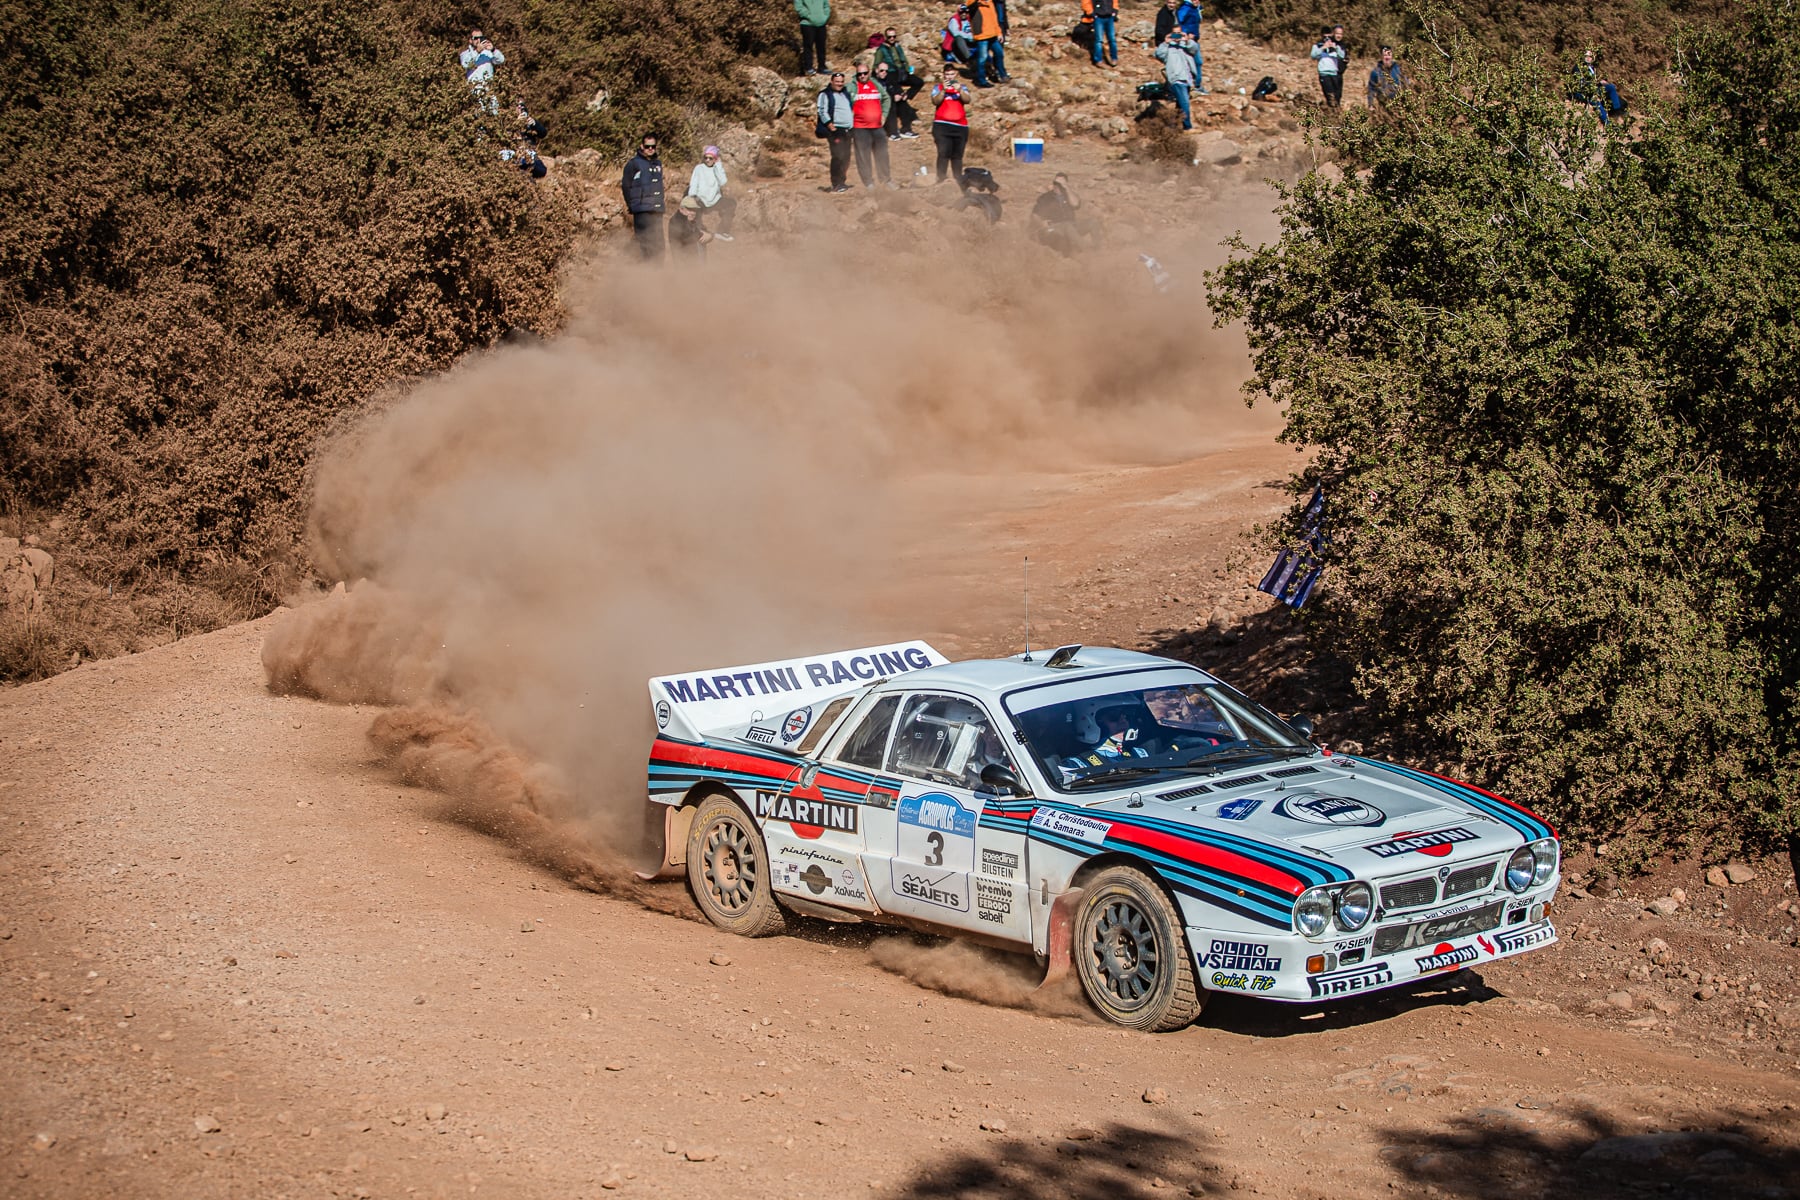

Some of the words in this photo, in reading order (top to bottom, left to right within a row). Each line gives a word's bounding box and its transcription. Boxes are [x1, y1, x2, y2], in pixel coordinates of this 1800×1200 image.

[663, 667, 802, 703] MARTINI
[805, 648, 932, 687] RACING
[745, 726, 776, 744] PIRELLI
[759, 793, 854, 830] MARTINI
[919, 800, 956, 830] ACROPOLIS
[1053, 820, 1086, 838] Samaras
[1058, 812, 1109, 832] Christodoulou
[924, 831, 945, 867] 3
[1370, 830, 1474, 855] MARTINI
[780, 846, 844, 865] pininfarina
[981, 863, 1014, 879] BILSTEIN
[902, 881, 960, 907] SEAJETS
[976, 882, 1012, 898] brembo
[979, 899, 1009, 912] FERODO
[978, 910, 1004, 924] sabelt
[1348, 936, 1373, 949] SIEM
[1493, 920, 1555, 953] PIRELLI
[1212, 942, 1266, 957] OLIO
[1420, 947, 1476, 971] MARTINI
[1212, 972, 1249, 990] Quick
[1251, 975, 1276, 990] Fit
[1307, 961, 1393, 998] PIRELLI
